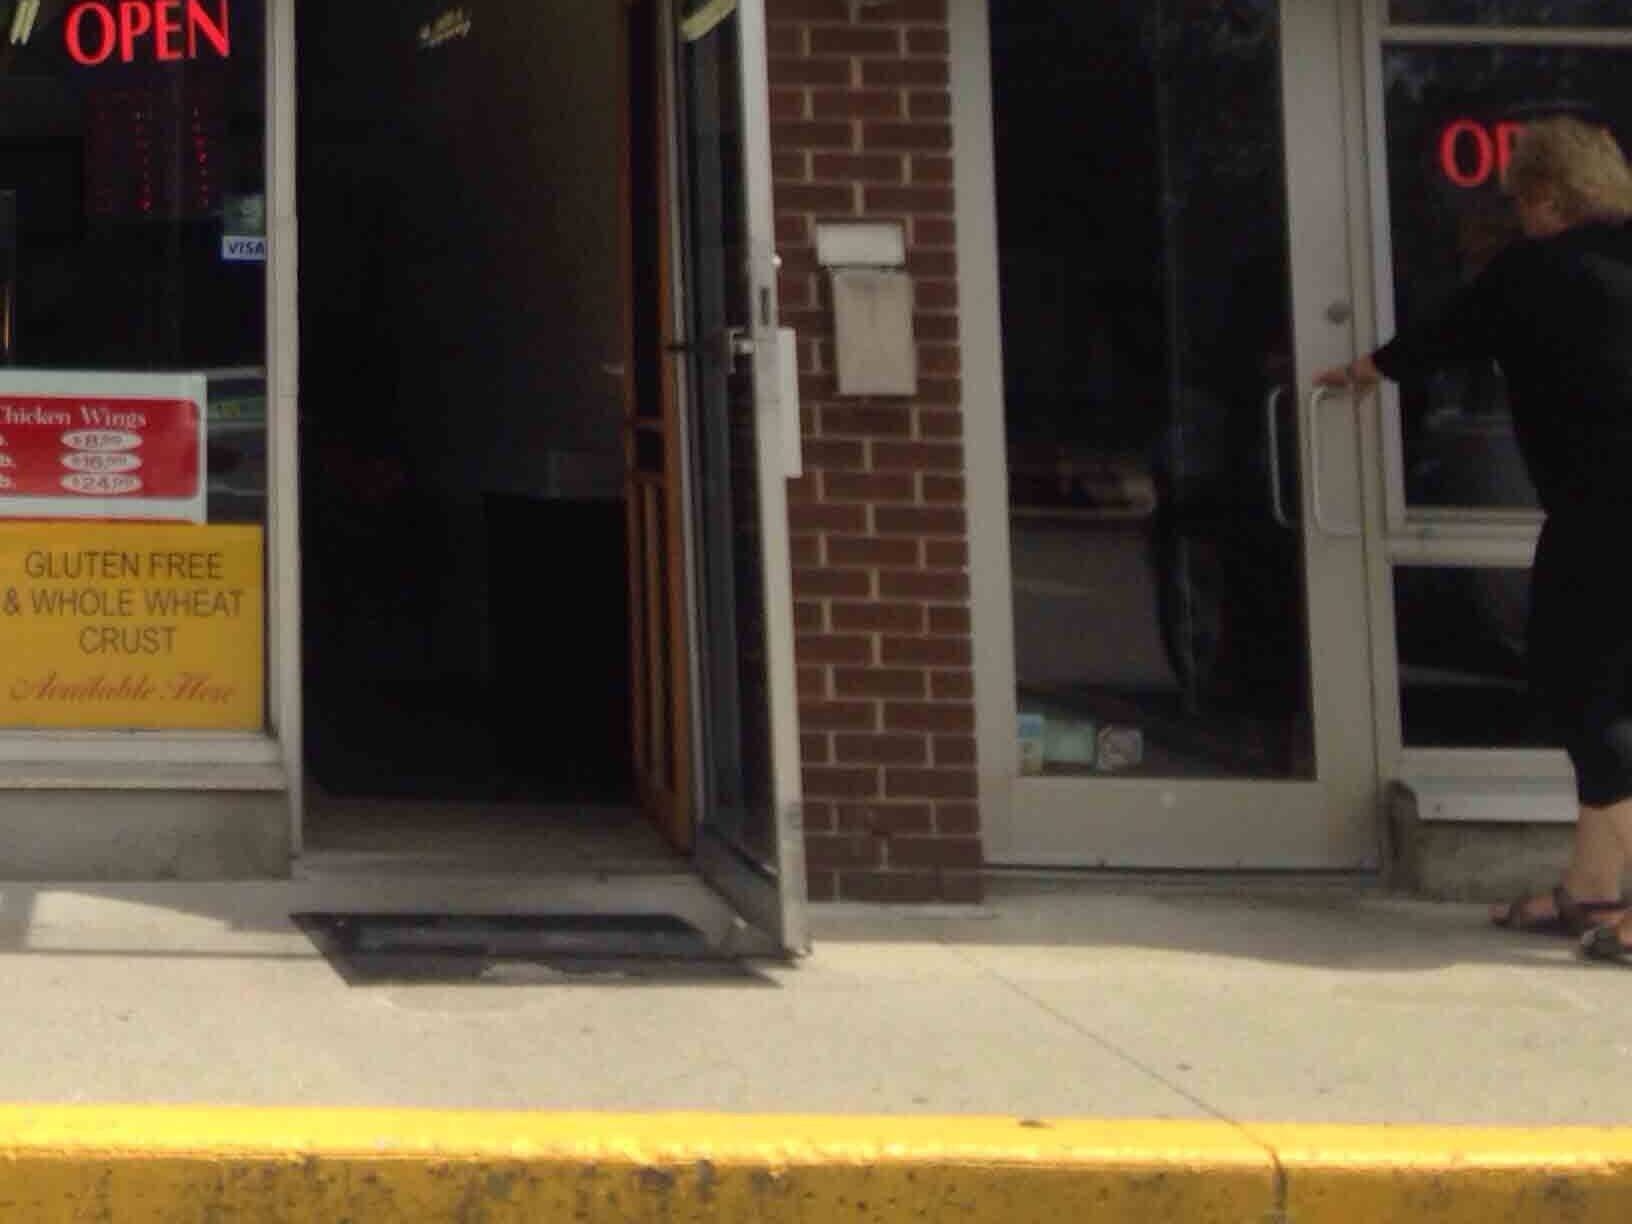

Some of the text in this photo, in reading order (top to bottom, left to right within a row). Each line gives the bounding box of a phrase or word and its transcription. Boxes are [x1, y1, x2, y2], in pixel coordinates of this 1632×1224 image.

[80, 405, 147, 429] Wings
[24, 551, 224, 580] GLUTEN FREE
[2, 588, 244, 617] & WHOLE WHEAT
[79, 628, 176, 655] CRUST
